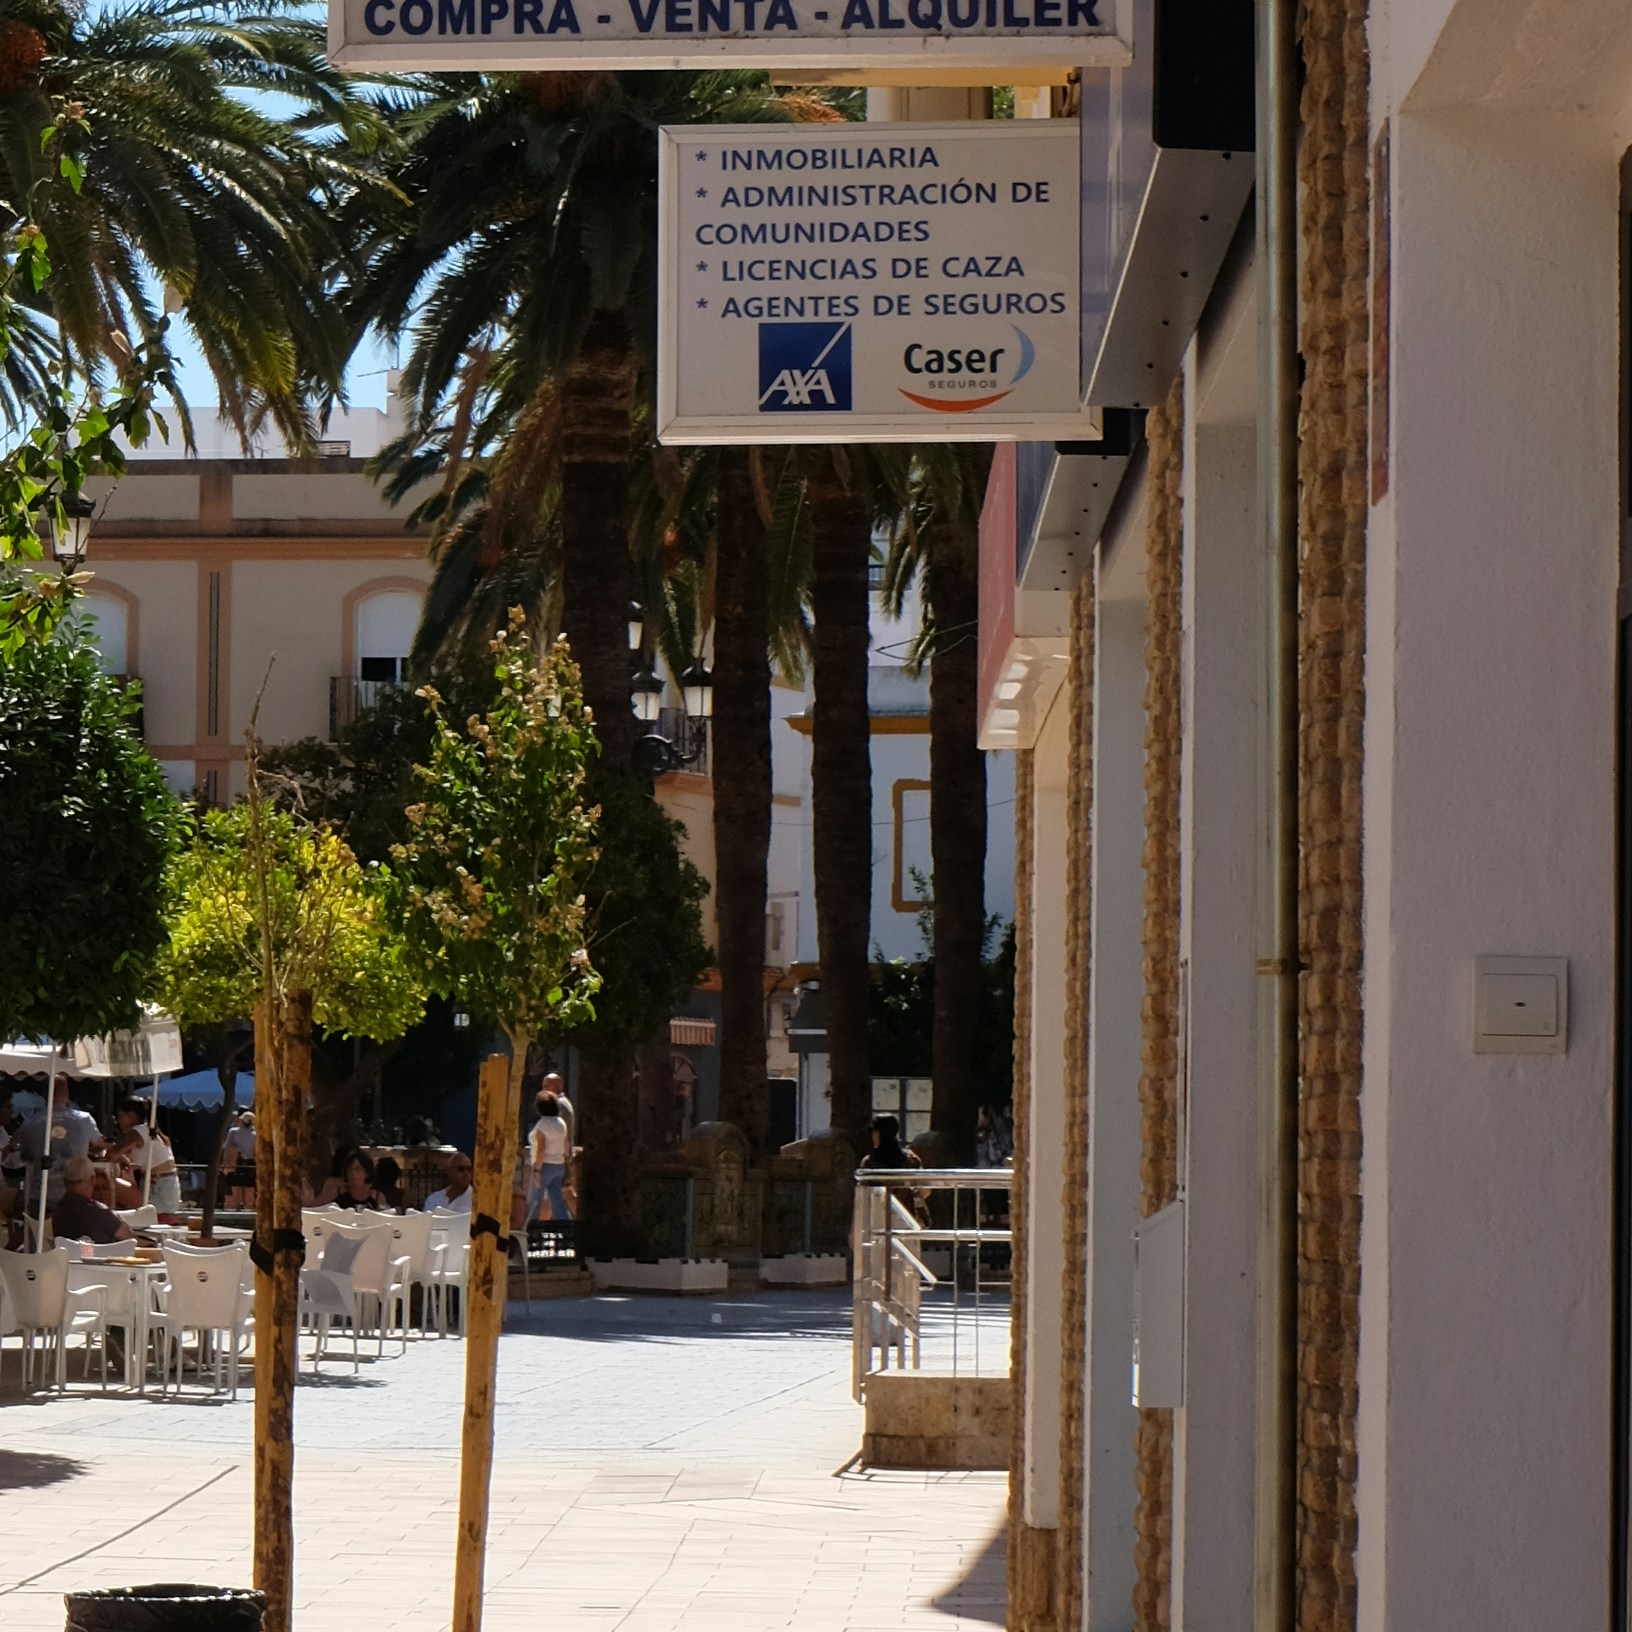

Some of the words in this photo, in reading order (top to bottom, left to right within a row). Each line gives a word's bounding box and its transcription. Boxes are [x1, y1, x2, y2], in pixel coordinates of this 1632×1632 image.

[721, 147, 940, 171] INMOBILIARIA
[720, 177, 997, 208] ADMINISTRACIÓN
[1012, 182, 1050, 203] DE
[695, 221, 930, 245] COMUNIDADES
[722, 258, 878, 282] LICENCIAS
[892, 258, 930, 279] DE
[942, 256, 1025, 278] CAZA
[721, 295, 859, 319] AGENTES
[873, 295, 912, 317] DE
[923, 292, 1067, 316] SEGUROS
[904, 343, 1006, 375] Caser
[759, 369, 836, 406] AXA
[928, 380, 998, 389] SEGUROS
